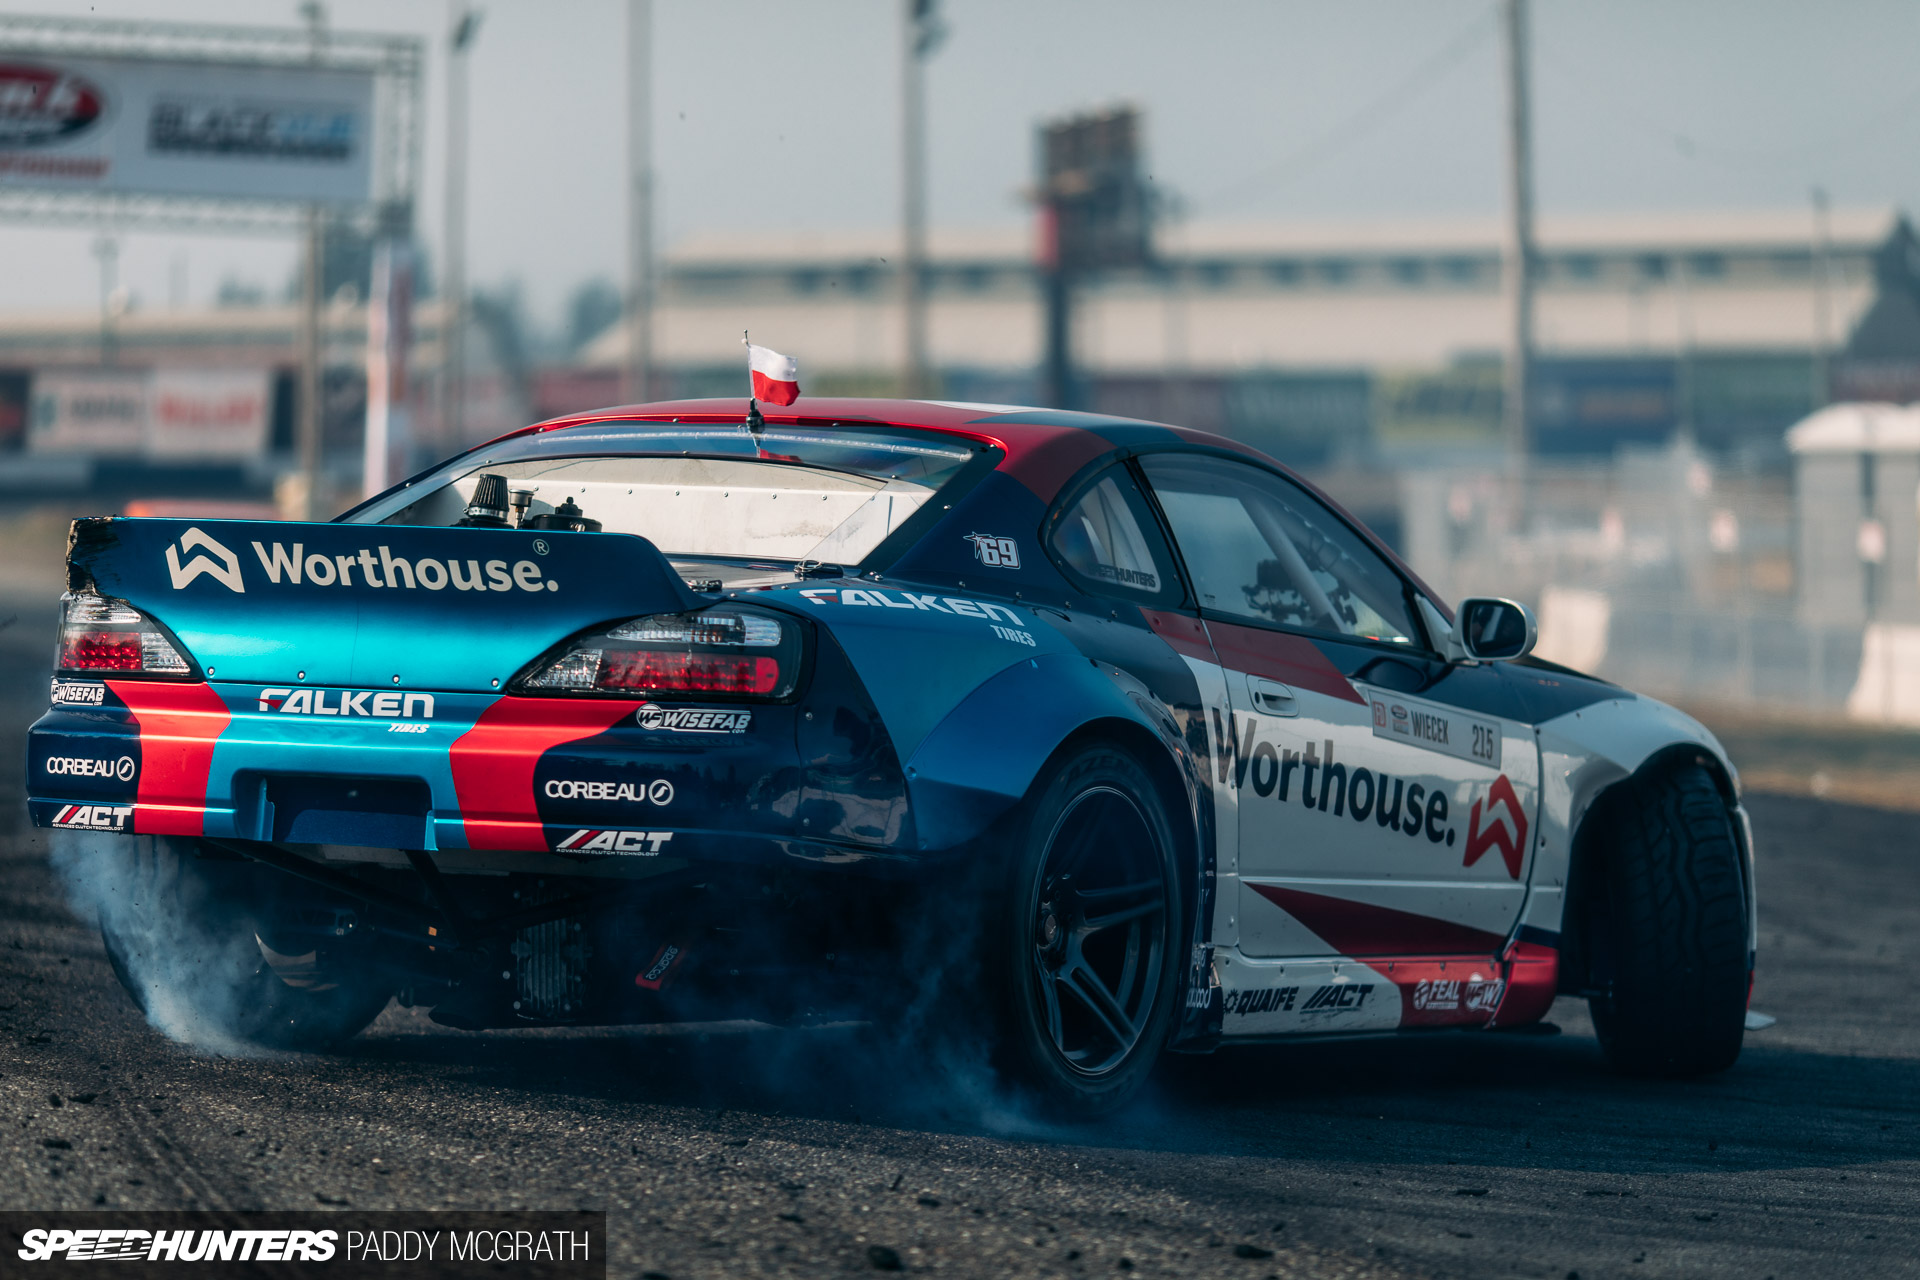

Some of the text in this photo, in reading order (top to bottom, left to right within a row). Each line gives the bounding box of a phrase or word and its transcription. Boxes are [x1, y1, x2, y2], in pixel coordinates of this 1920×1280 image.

[251, 541, 559, 592] Worthouse.
[979, 536, 1020, 569] 69
[799, 589, 1025, 627] FALKEN
[990, 624, 1036, 647] TIRES
[58, 685, 105, 702] WISEFAB
[253, 688, 435, 718] FALKEN
[387, 723, 429, 734] TIRES
[664, 711, 751, 729] WISEFAB
[1410, 710, 1449, 745] WIECEK
[1472, 724, 1494, 760] 215
[46, 757, 115, 778] CORBEAU
[1211, 707, 1455, 847] Worthouse.
[545, 780, 646, 802] CORBEAU
[1235, 986, 1299, 1016] QUAIFE
[1428, 979, 1460, 1000] FEAL
